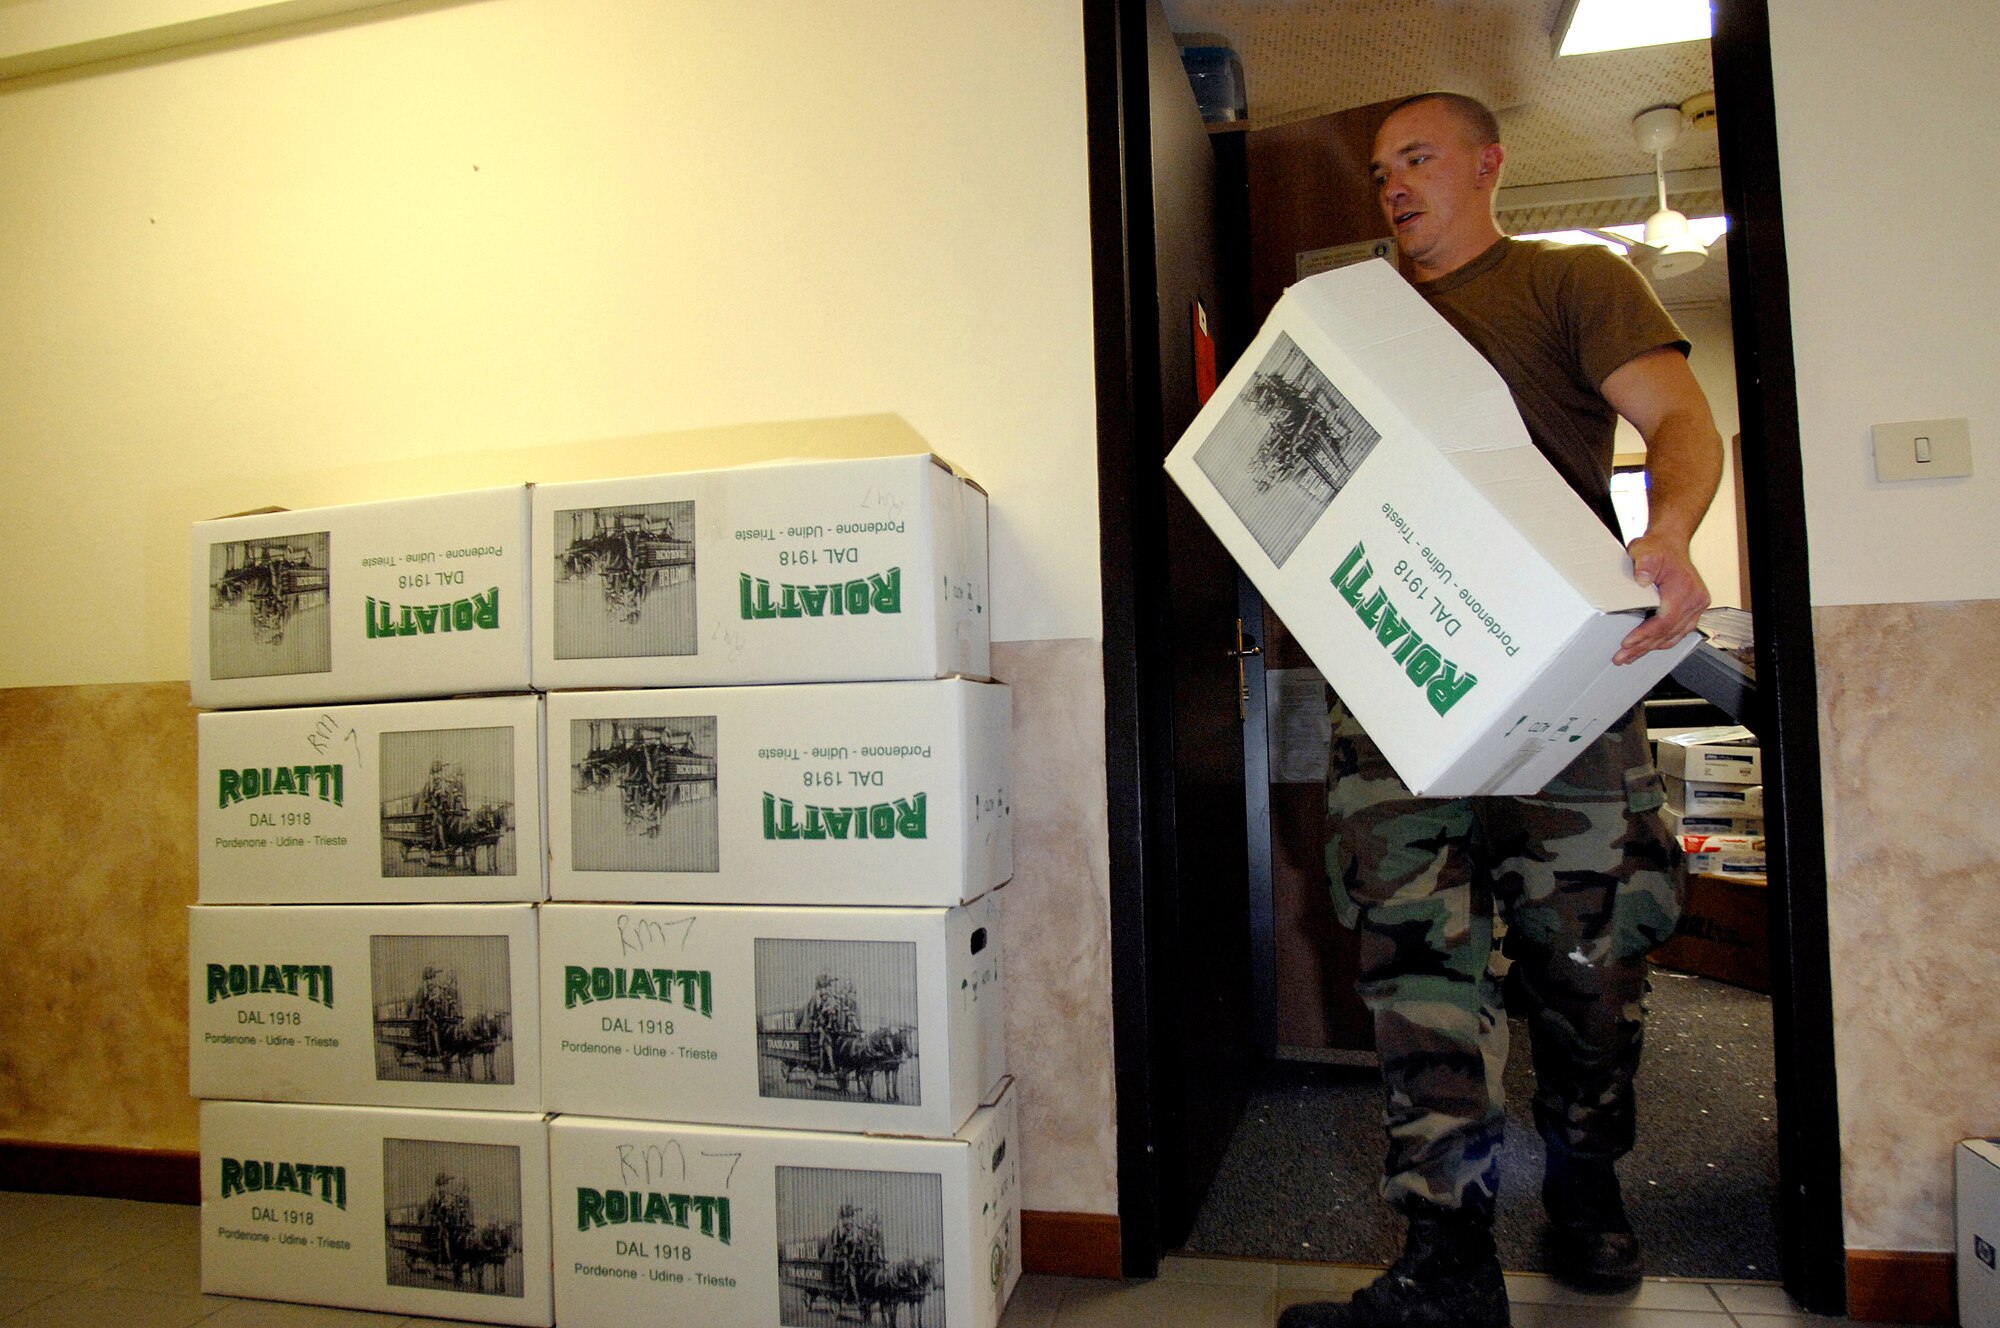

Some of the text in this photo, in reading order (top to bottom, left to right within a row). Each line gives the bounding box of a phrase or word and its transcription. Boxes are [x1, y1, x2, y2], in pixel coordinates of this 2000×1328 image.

[788, 526, 823, 538] Udine
[836, 521, 904, 534] Pordenone
[1381, 503, 1414, 544] Trieste
[735, 529, 775, 541] Trieste
[406, 552, 436, 564] Udine
[445, 546, 503, 558] Pordenone
[780, 548, 857, 566] DAL 1918
[362, 557, 396, 567] Trieste
[1421, 547, 1452, 584] Udine
[399, 570, 464, 589] DAL 1918
[739, 566, 902, 621] ROIATTI
[1394, 560, 1462, 637] DAL 1918
[366, 586, 500, 639] ROIATTI
[1329, 540, 1478, 718] ROIATTI
[1459, 588, 1520, 657] Pordenone
[758, 749, 800, 760] Trieste
[812, 747, 848, 760] Udine
[861, 746, 931, 758] Pordenone
[219, 764, 343, 809] ROIATTI
[803, 770, 884, 787] DAL 1918
[250, 812, 311, 827] DAL 1918
[762, 791, 928, 840] ROIATTI
[216, 838, 267, 848] Pordenone
[276, 836, 304, 847] Udine
[313, 836, 347, 846] Trieste
[207, 963, 334, 1009] ROIATTI
[564, 965, 713, 1019] ROIATTI
[238, 1010, 301, 1025] DAL 1918
[602, 1017, 674, 1035] DAL 1918
[205, 1033, 256, 1045] Pordenone
[266, 1035, 294, 1046] Udine
[304, 1036, 339, 1047] Trieste
[562, 1040, 621, 1054] Pordenone
[634, 1045, 666, 1057] Udine
[678, 1047, 717, 1060] Trieste
[221, 1158, 347, 1211] ROIATTI
[252, 1207, 313, 1225] DAL 1918
[577, 1187, 732, 1246] ROIATTI
[218, 1227, 269, 1243] Pordenone
[279, 1234, 307, 1246] Udine
[317, 1236, 350, 1250] Trieste
[617, 1241, 691, 1261] DAL 1918
[575, 1263, 637, 1280] Pordenone
[649, 1269, 683, 1283] Udine
[696, 1273, 736, 1287] Trieste
